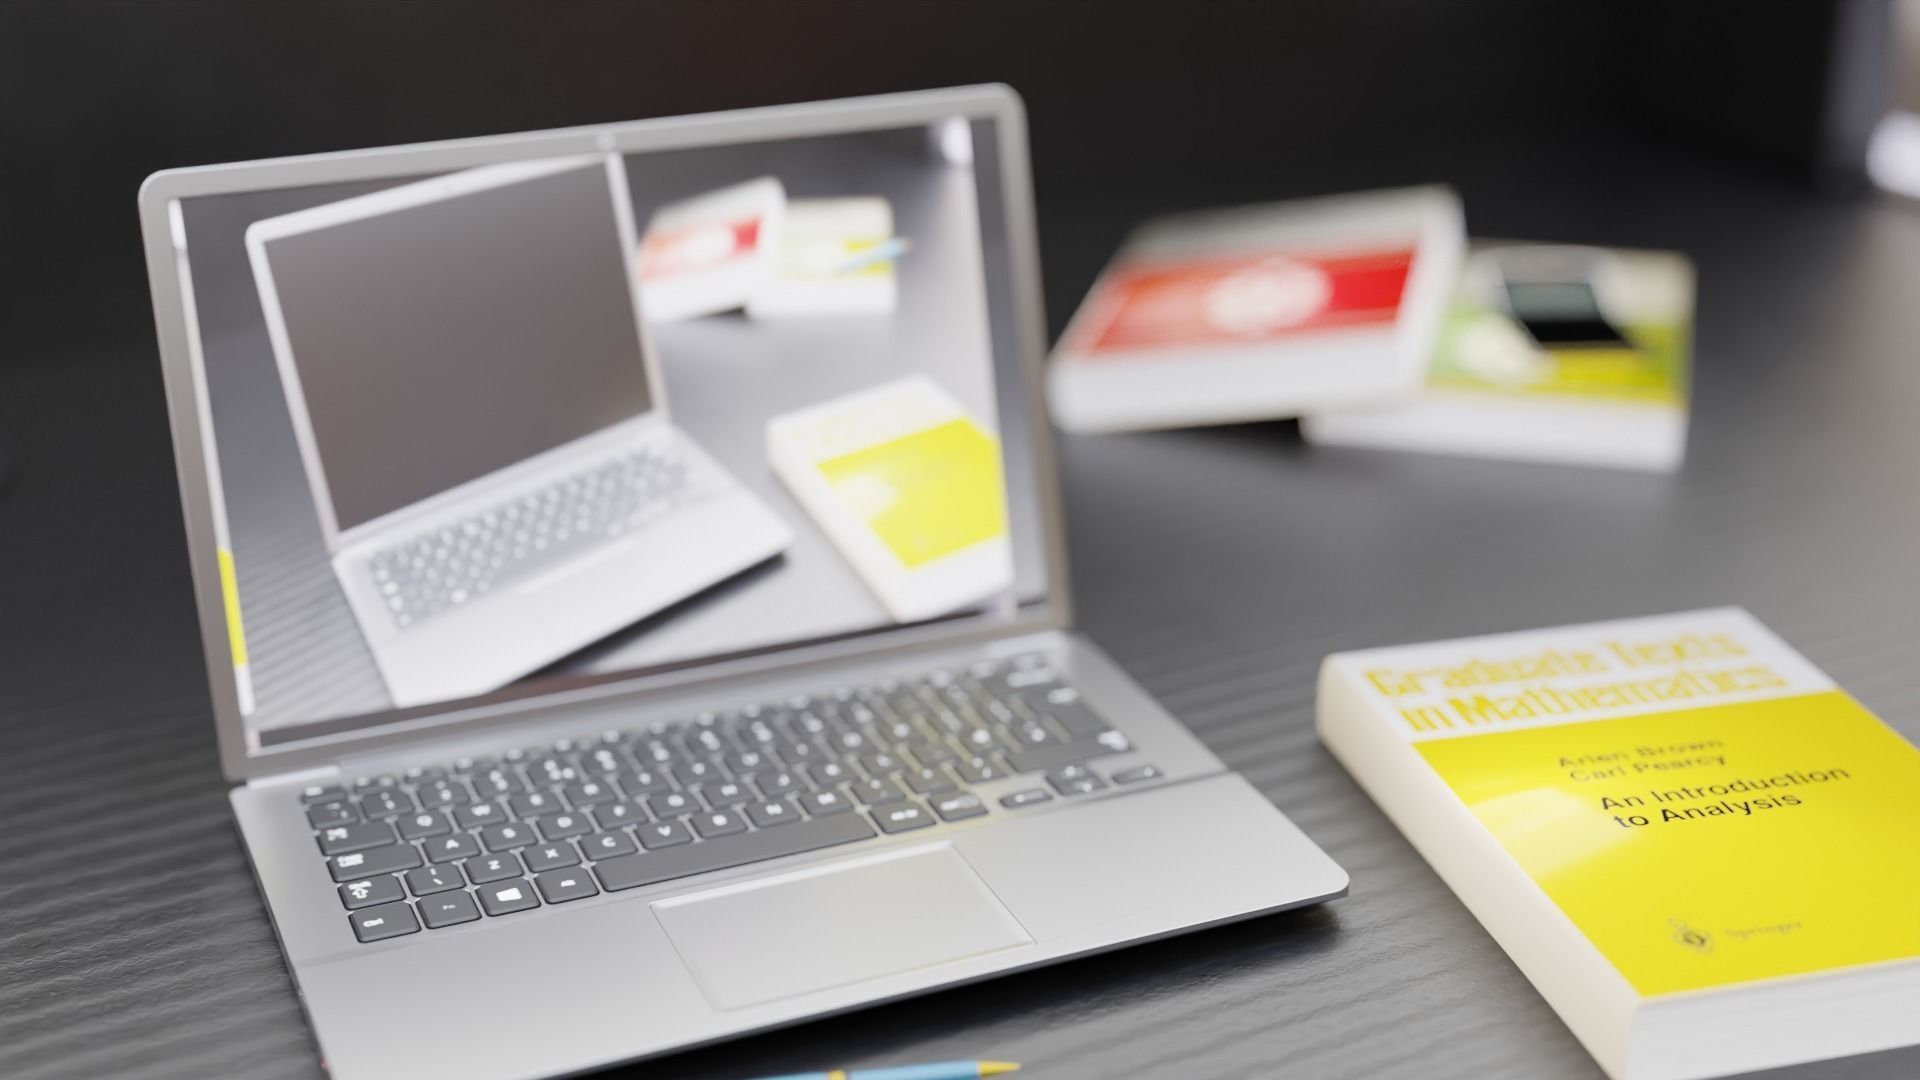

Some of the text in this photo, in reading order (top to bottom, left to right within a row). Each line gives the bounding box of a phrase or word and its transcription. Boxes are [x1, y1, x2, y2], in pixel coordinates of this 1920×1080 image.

[1364, 650, 1609, 697] Graduate
[1399, 666, 1787, 731] in Mathematics
[1635, 740, 1724, 757] Brown
[1570, 756, 1725, 781] Carl Pearcy
[1601, 768, 1850, 810] An Introduction
[1614, 795, 1802, 828] to Analysis
